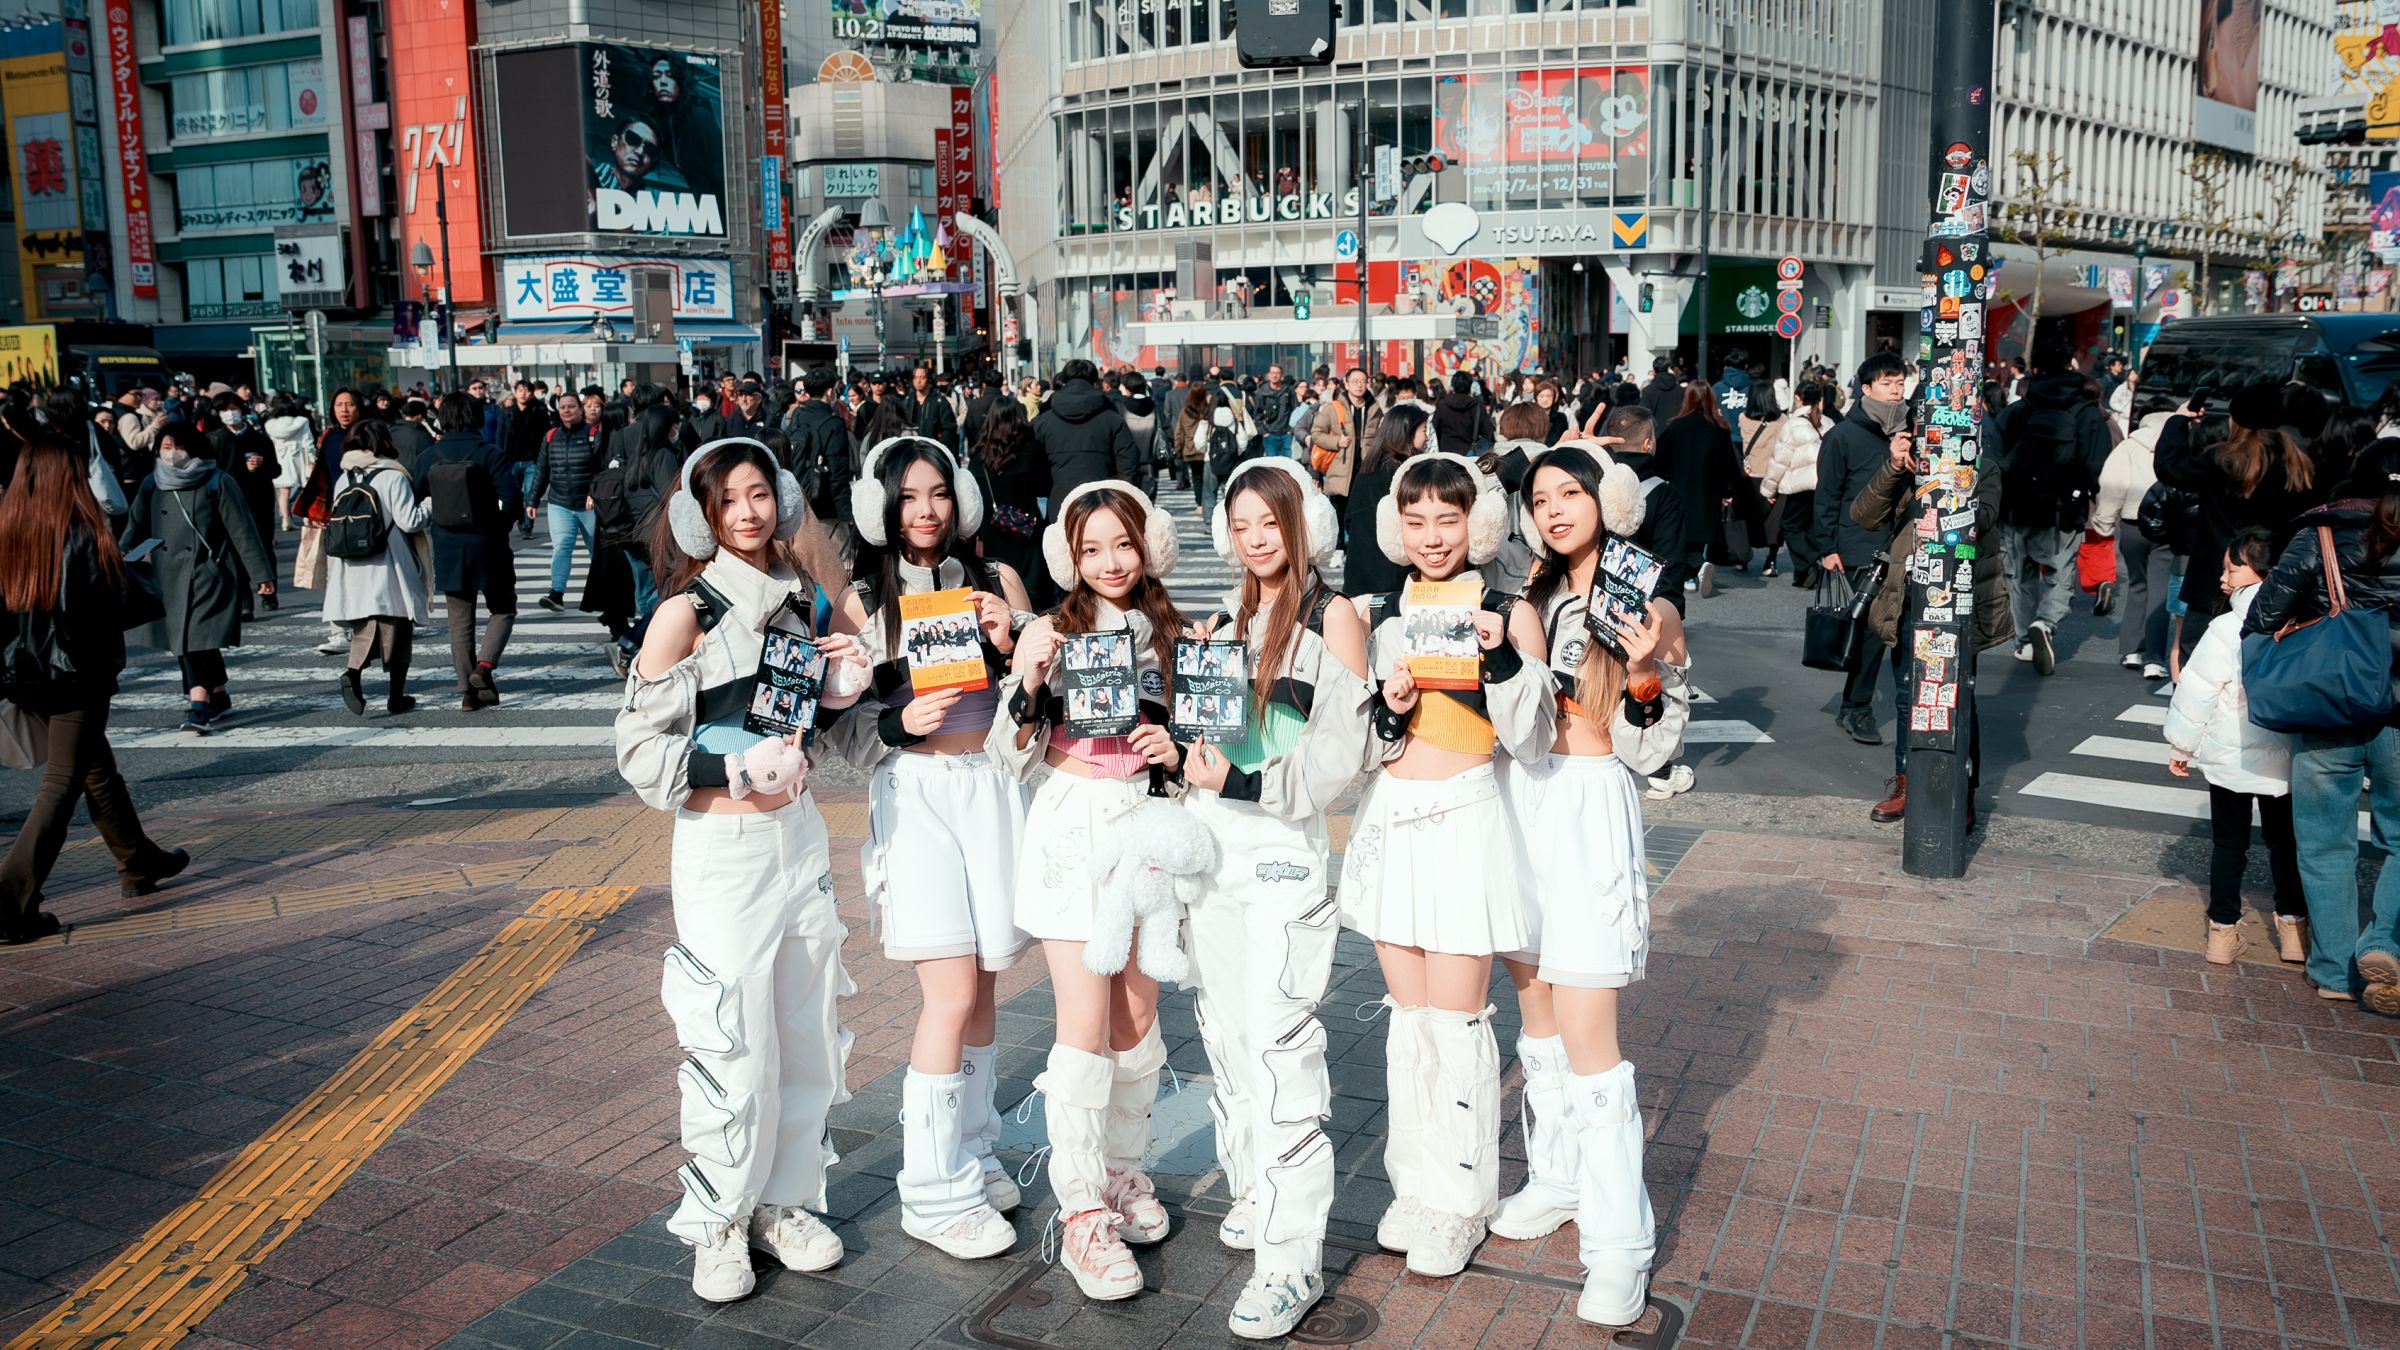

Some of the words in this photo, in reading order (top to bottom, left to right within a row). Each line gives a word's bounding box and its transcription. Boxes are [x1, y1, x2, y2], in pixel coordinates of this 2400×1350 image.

[836, 18, 879, 39] 10.2
[887, 25, 910, 33] TOKYO
[923, 25, 977, 43] 放送開始
[592, 50, 615, 119] 外道の歌
[111, 25, 142, 196] ウィンターフルーツギフト
[938, 140, 948, 159] BIG
[954, 98, 972, 184] カラオケ
[23, 136, 66, 195] 薬
[403, 95, 467, 215] クスリ
[1540, 163, 1577, 173] SHIBUYA
[1579, 161, 1618, 171] TSUTAYA
[838, 168, 878, 179] れいわ
[940, 160, 949, 187] ECHO
[826, 182, 879, 194] クリニック
[596, 187, 724, 235] DMM
[1119, 187, 1360, 231] STARBUCKS
[1492, 224, 1597, 244] TSUTAYA
[517, 267, 716, 306] 大盛堂店
[1725, 324, 1779, 334] STARBUCKS
